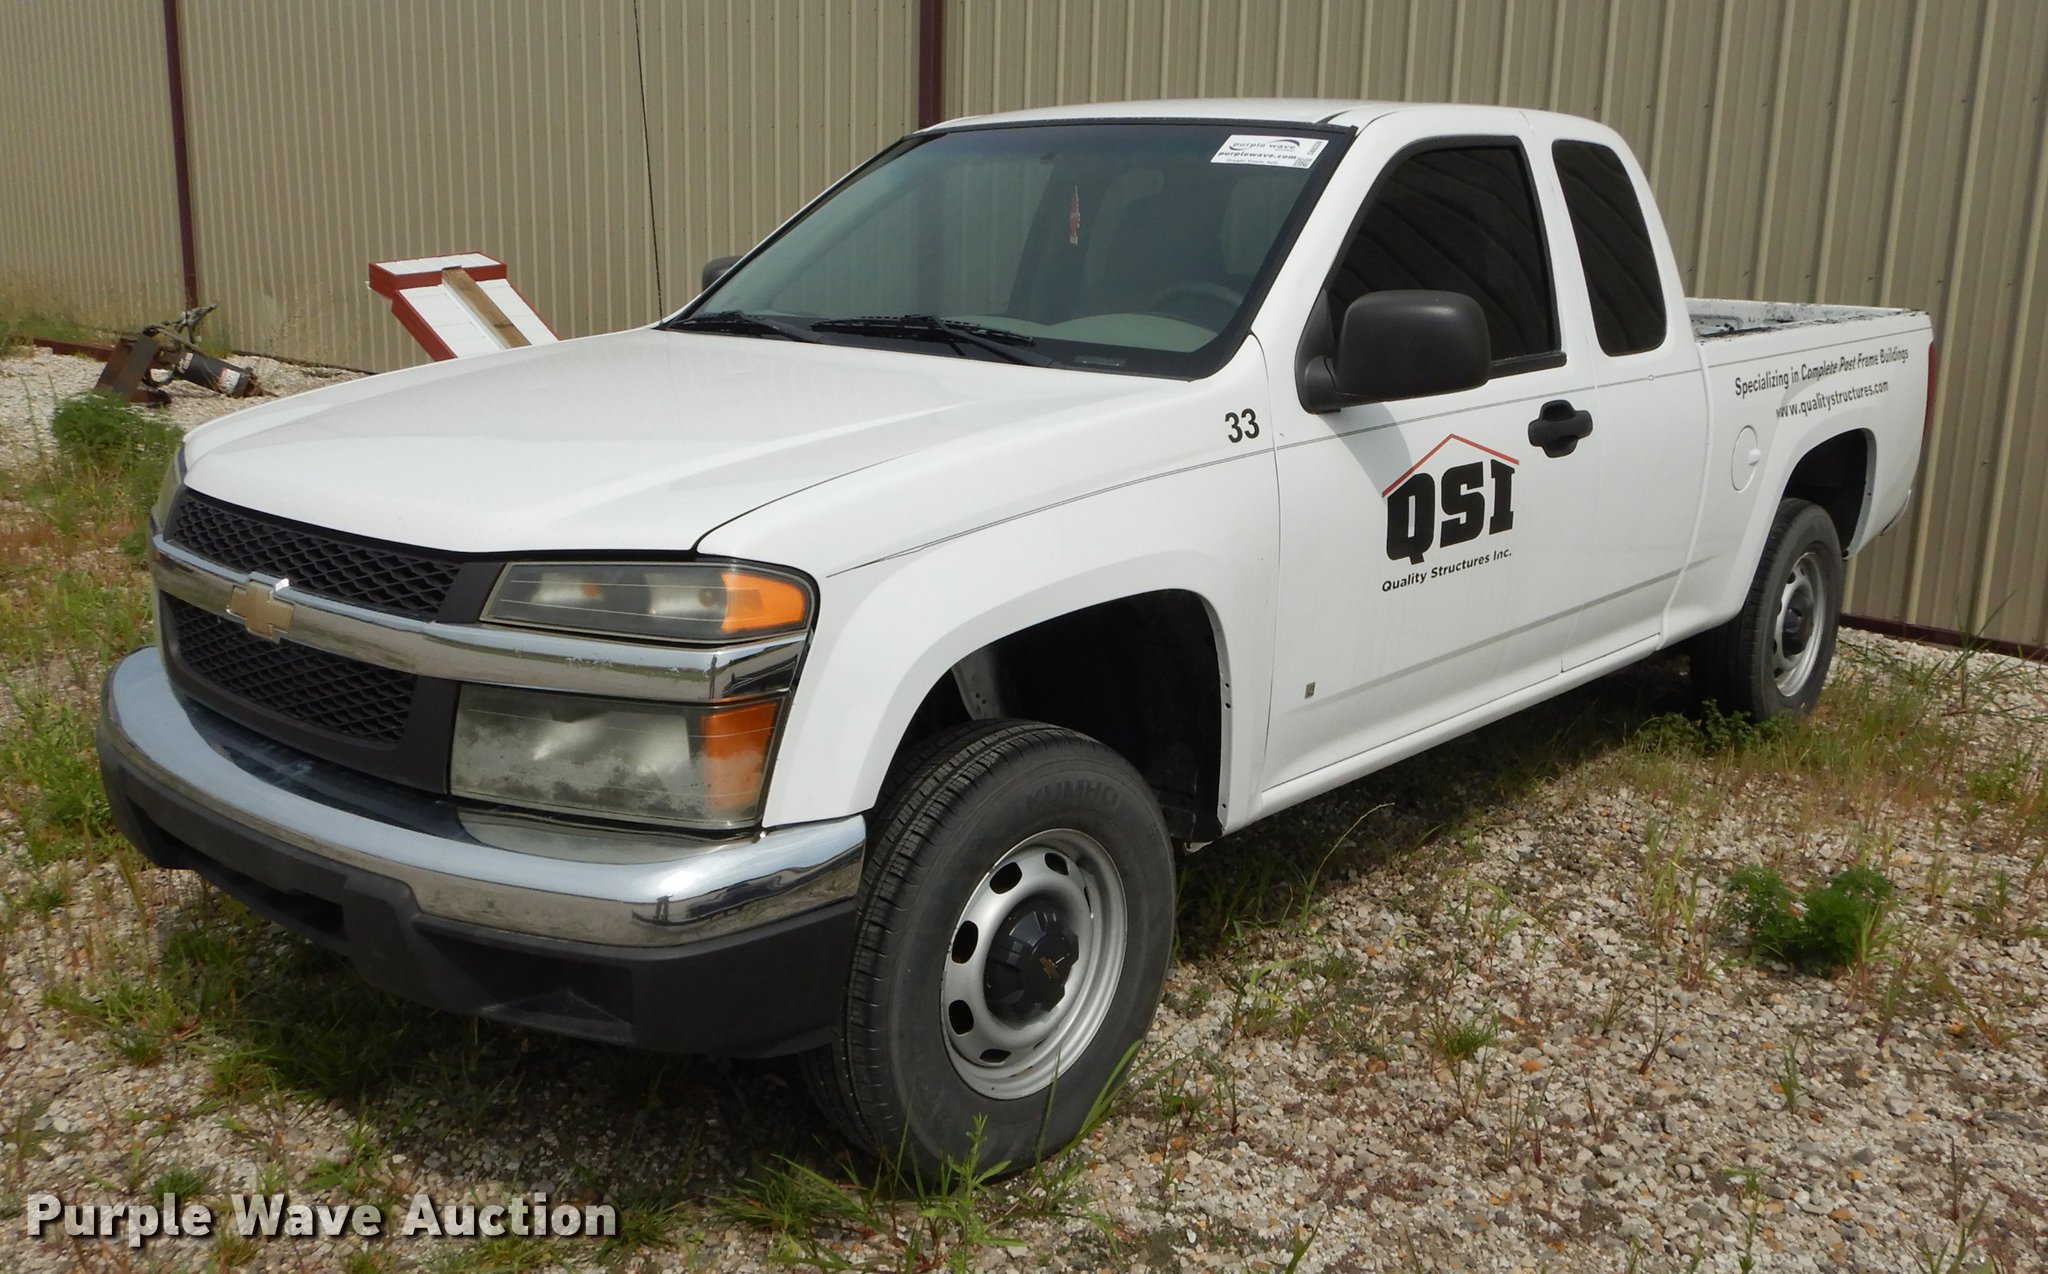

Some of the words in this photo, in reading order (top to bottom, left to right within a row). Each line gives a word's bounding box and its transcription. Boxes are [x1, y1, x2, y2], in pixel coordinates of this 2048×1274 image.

[1218, 150, 1297, 160] purplewave.com
[1232, 141, 1266, 149] purple
[1735, 371, 1789, 399] Specializing
[1791, 366, 1799, 382] in
[1801, 360, 1838, 382] Complete
[1839, 355, 1856, 372] Post
[1857, 352, 1879, 367] Frame
[1880, 346, 1909, 364] Buildings
[1225, 408, 1260, 443] 33
[1386, 459, 1515, 565] QSI
[1382, 571, 1427, 592] Quality
[1431, 553, 1490, 579] Structures
[1493, 549, 1512, 561] Inc.
[1025, 779, 1119, 815] KUMHO
